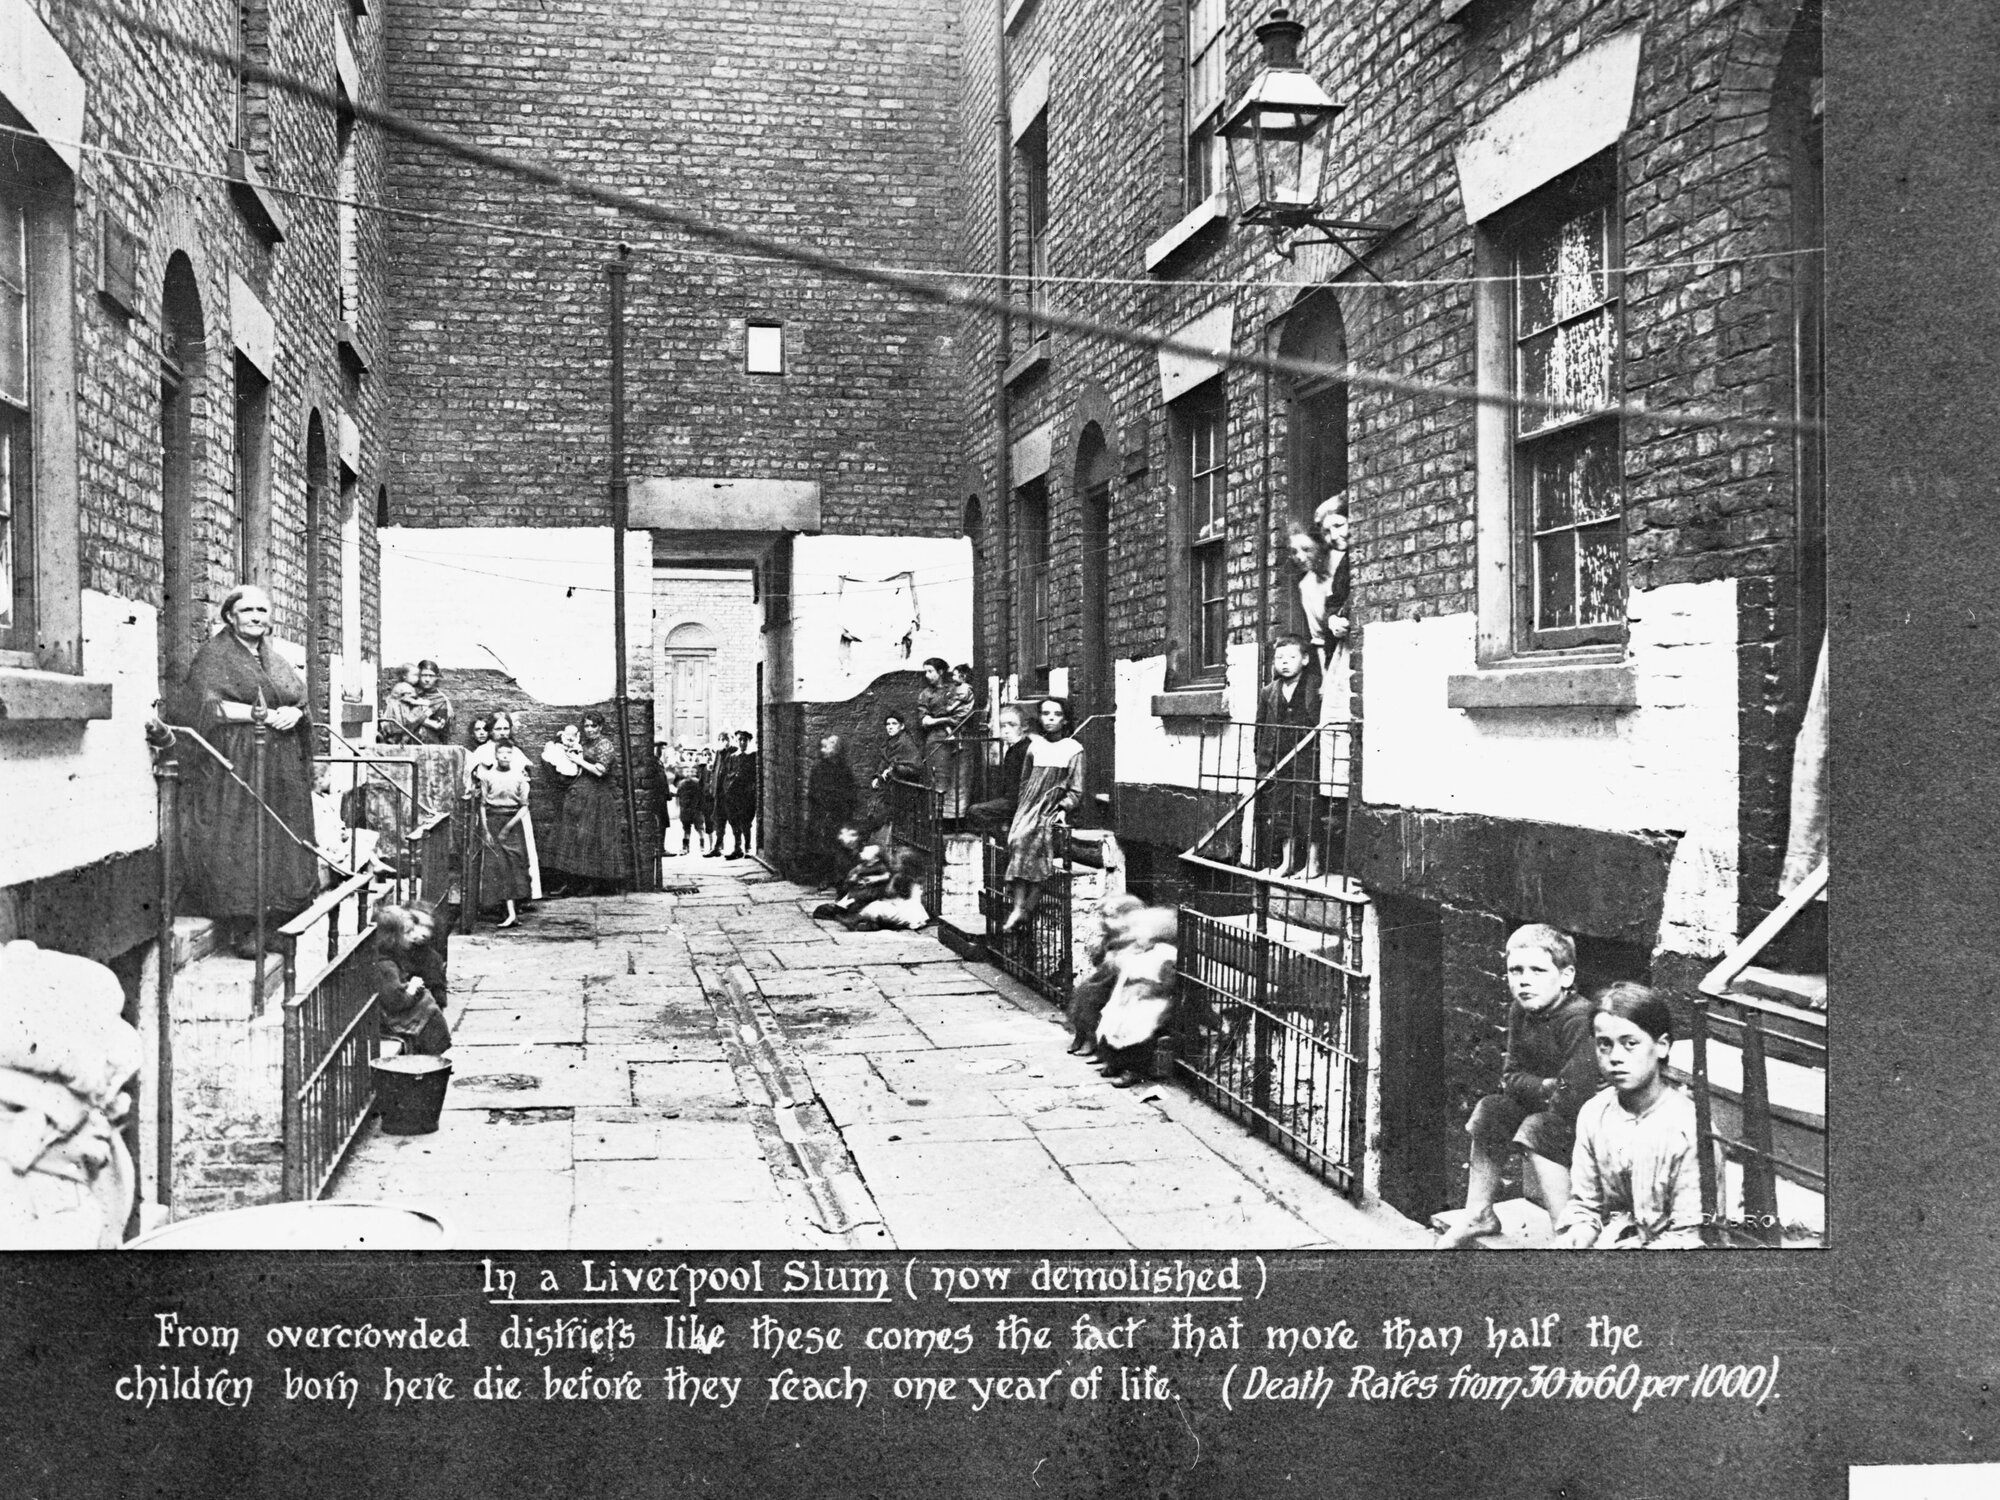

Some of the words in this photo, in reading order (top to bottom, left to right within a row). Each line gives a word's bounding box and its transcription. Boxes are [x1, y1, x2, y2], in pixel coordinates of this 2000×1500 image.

[482, 1259, 515, 1300] In
[540, 1270, 559, 1292] a
[581, 1259, 764, 1306] Liverpool
[782, 1259, 891, 1298] Slum
[154, 1311, 239, 1355] From
[266, 1317, 470, 1349] overcrowded
[500, 1314, 636, 1357] districts
[664, 1314, 726, 1355] like
[750, 1314, 844, 1358] these
[864, 1327, 974, 1358] comes
[995, 1314, 1052, 1355] the
[1071, 1313, 1147, 1351] fact
[1171, 1312, 1244, 1358] that
[1266, 1319, 1359, 1358] more
[1382, 1315, 1463, 1358] than
[1485, 1312, 1560, 1359] half
[1585, 1314, 1643, 1356] the
[115, 1364, 253, 1410] children
[284, 1366, 359, 1410] born
[383, 1366, 455, 1408] here
[473, 1365, 522, 1400] die
[542, 1365, 642, 1401] before
[663, 1364, 742, 1409] they
[767, 1367, 868, 1408] reach
[893, 1377, 957, 1411] one
[967, 1368, 1063, 1412] year
[1070, 1365, 1103, 1400] of
[1120, 1364, 1181, 1401] life.
[1347, 1364, 1438, 1401] Rates
[1448, 1363, 1523, 1411] from
[1632, 1374, 1690, 1412] per
